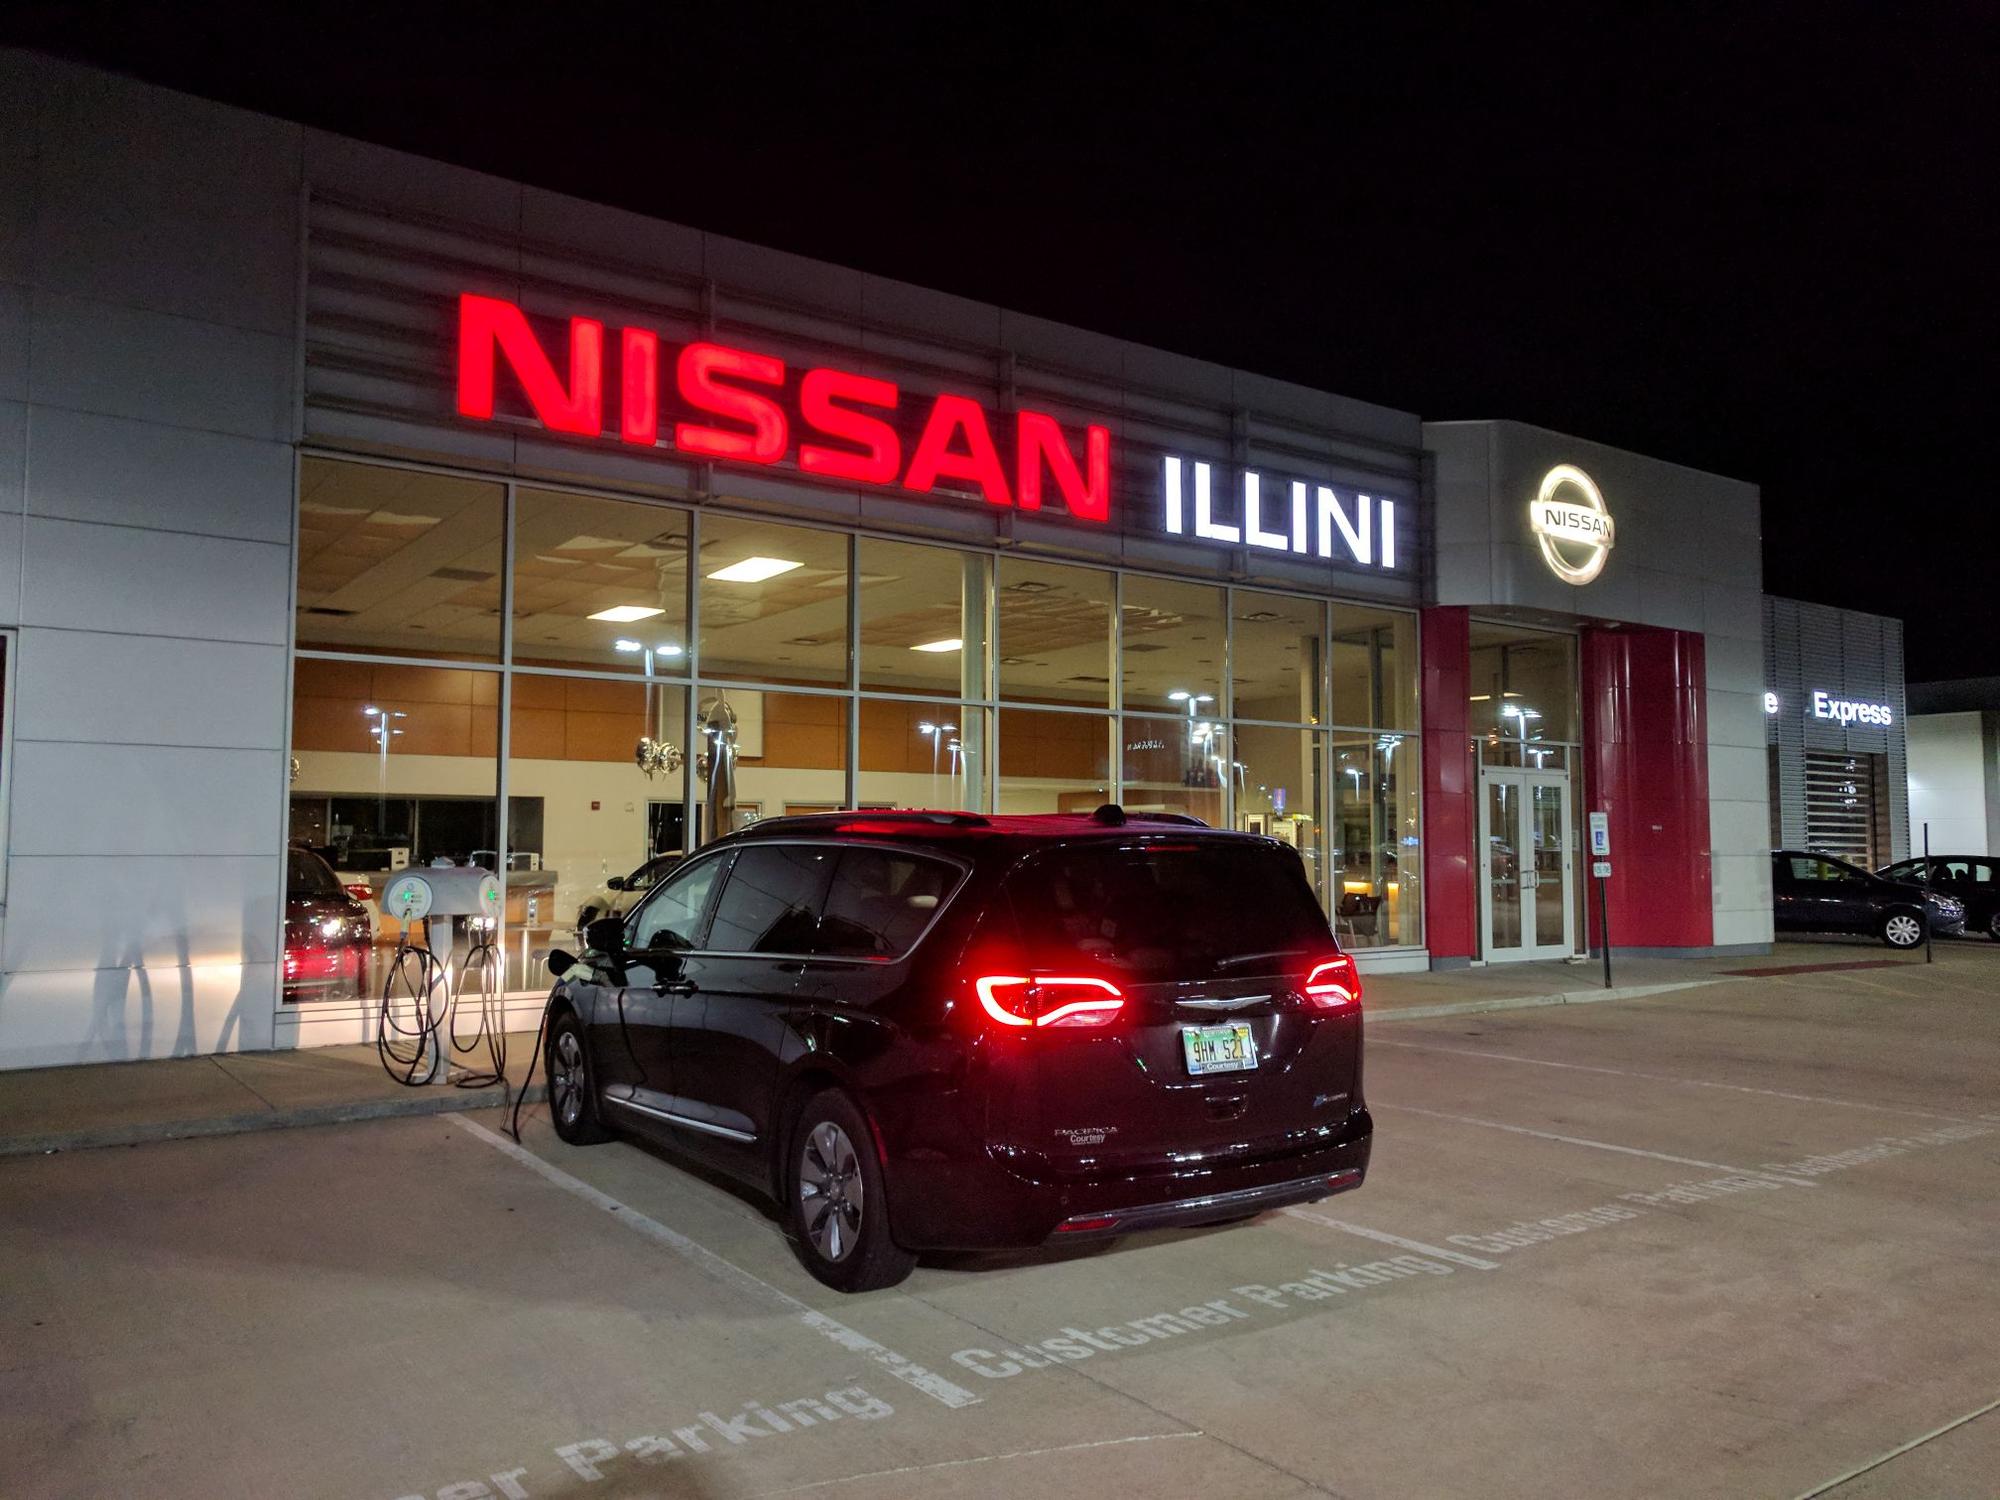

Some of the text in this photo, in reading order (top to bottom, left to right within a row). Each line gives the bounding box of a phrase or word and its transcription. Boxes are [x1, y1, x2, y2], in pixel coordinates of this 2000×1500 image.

[457, 292, 1112, 522] NISSAN
[1163, 455, 1396, 569] ILLINI
[1545, 509, 1612, 539] NISSAN
[1813, 691, 1893, 727] Express
[950, 1254, 1455, 1379] Customer Parking
[554, 1386, 894, 1482] Parking
